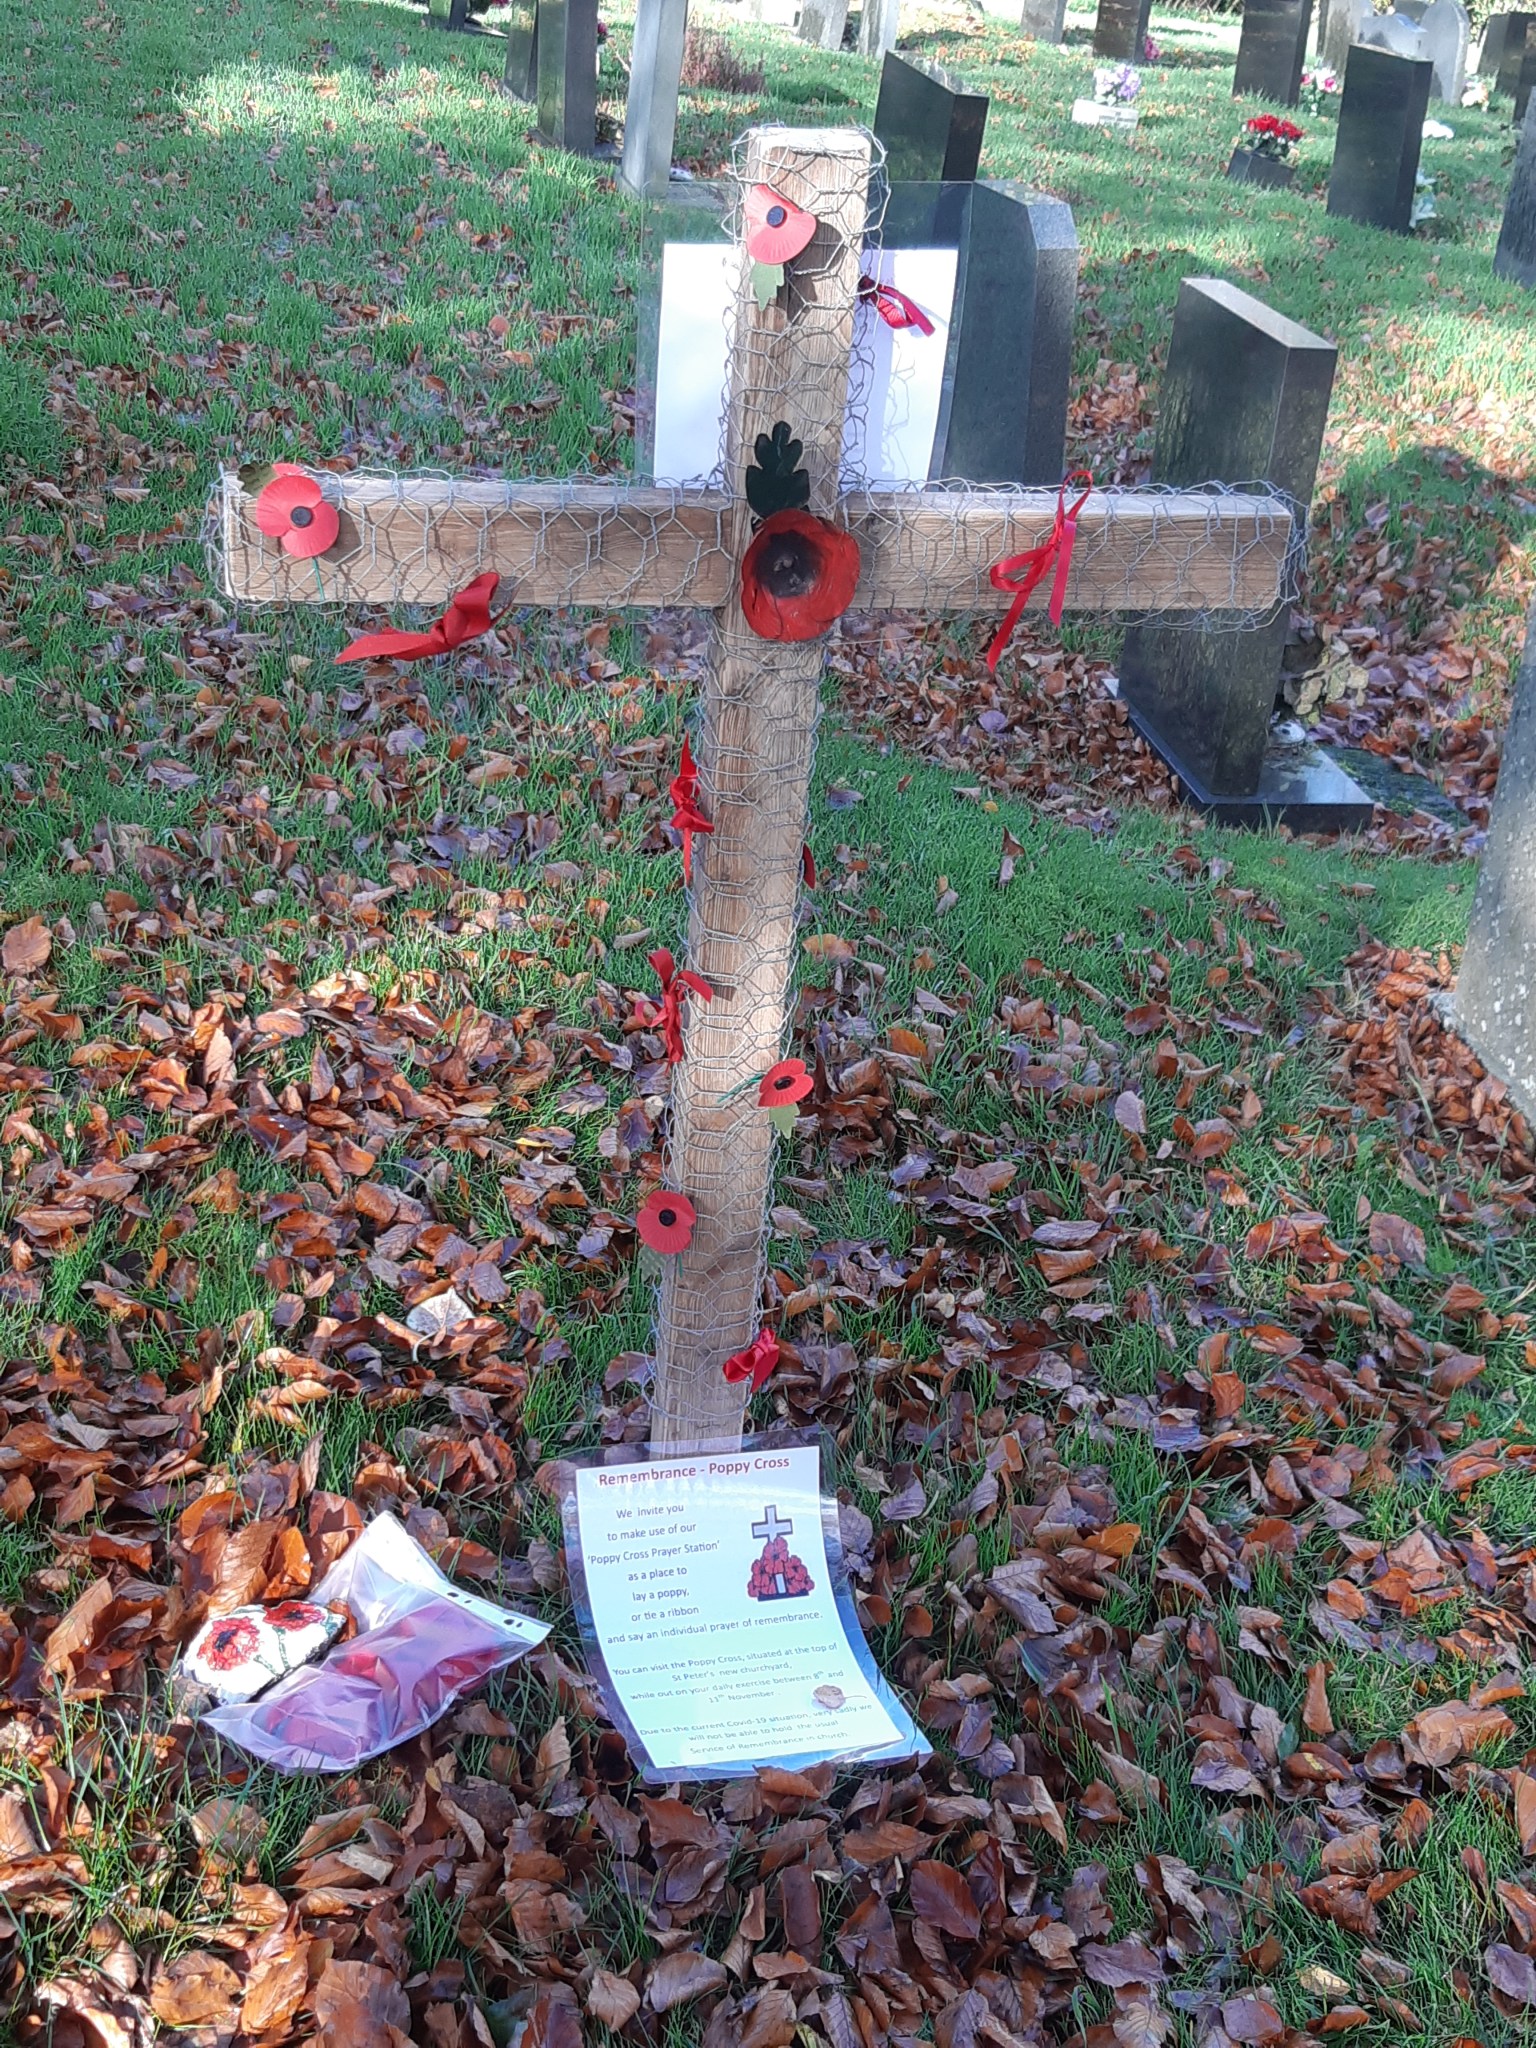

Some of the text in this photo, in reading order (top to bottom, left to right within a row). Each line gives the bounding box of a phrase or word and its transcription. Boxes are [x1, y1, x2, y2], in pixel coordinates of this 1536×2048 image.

[599, 1467, 696, 1486] Remembrance
[709, 1461, 750, 1475] Poppy
[754, 1457, 790, 1470] Cross
[616, 1504, 684, 1519] We invite you
[607, 1523, 697, 1541] to make use of our
[623, 1550, 649, 1561] Cross
[651, 1546, 681, 1558] Prayer
[628, 1573, 639, 1581] as
[649, 1568, 674, 1580] place
[677, 1567, 687, 1575] to
[632, 1588, 690, 1602] lay a poppy,
[631, 1614, 641, 1622] or
[644, 1611, 657, 1620] tie
[668, 1606, 699, 1617] ribbon
[607, 1611, 823, 1644] and say an individual prayer of remembrance.
[613, 1668, 630, 1676] You
[632, 1666, 648, 1674] can
[651, 1662, 669, 1671] visit
[671, 1660, 686, 1669] the
[688, 1658, 716, 1668] Poppy
[717, 1655, 745, 1663] Cross,
[746, 1650, 782, 1660] situated
[795, 1646, 810, 1654] the
[811, 1645, 827, 1653] top
[828, 1642, 838, 1650] of
[672, 1674, 682, 1682] St
[684, 1670, 715, 1680] Peter's
[740, 1662, 793, 1674] churchyard,
[630, 1692, 655, 1700] while
[657, 1691, 674, 1699] out
[689, 1687, 709, 1695] your
[712, 1684, 733, 1692] daily
[736, 1679, 771, 1688] exercise
[772, 1674, 812, 1684] between
[828, 1670, 844, 1678] and
[673, 1725, 689, 1733] the
[691, 1722, 725, 1731] current
[727, 1717, 767, 1727] Covid-19
[813, 1709, 833, 1717] very
[772, 1725, 793, 1733] hold
[815, 1720, 839, 1728] usual
[690, 1746, 724, 1754] Service
[738, 1737, 804, 1750] Remembrance
